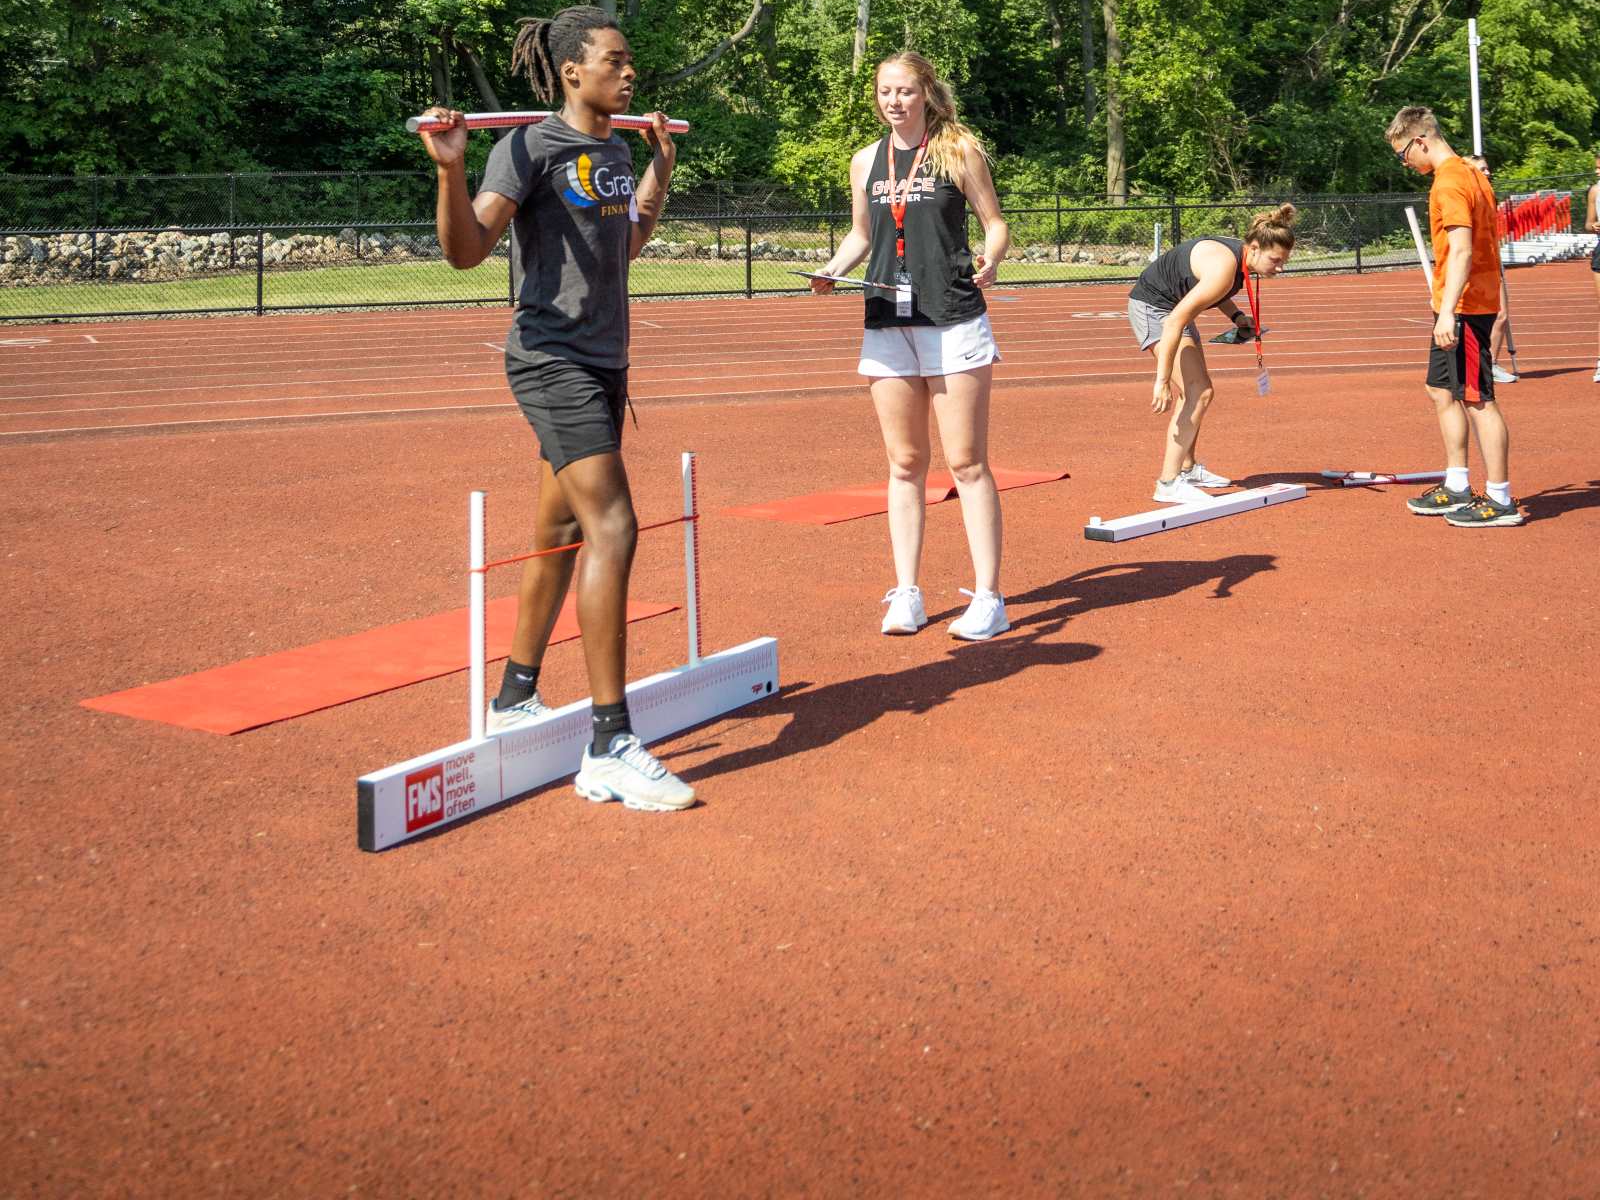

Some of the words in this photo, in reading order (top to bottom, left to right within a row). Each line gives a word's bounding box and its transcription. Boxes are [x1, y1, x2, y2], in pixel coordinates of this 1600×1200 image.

[594, 167, 635, 197] Grac
[880, 193, 921, 204] SOCER
[446, 752, 476, 770] move
[446, 767, 473, 786] well.
[407, 775, 442, 822] FMS
[446, 782, 476, 800] move
[446, 797, 476, 818] often
